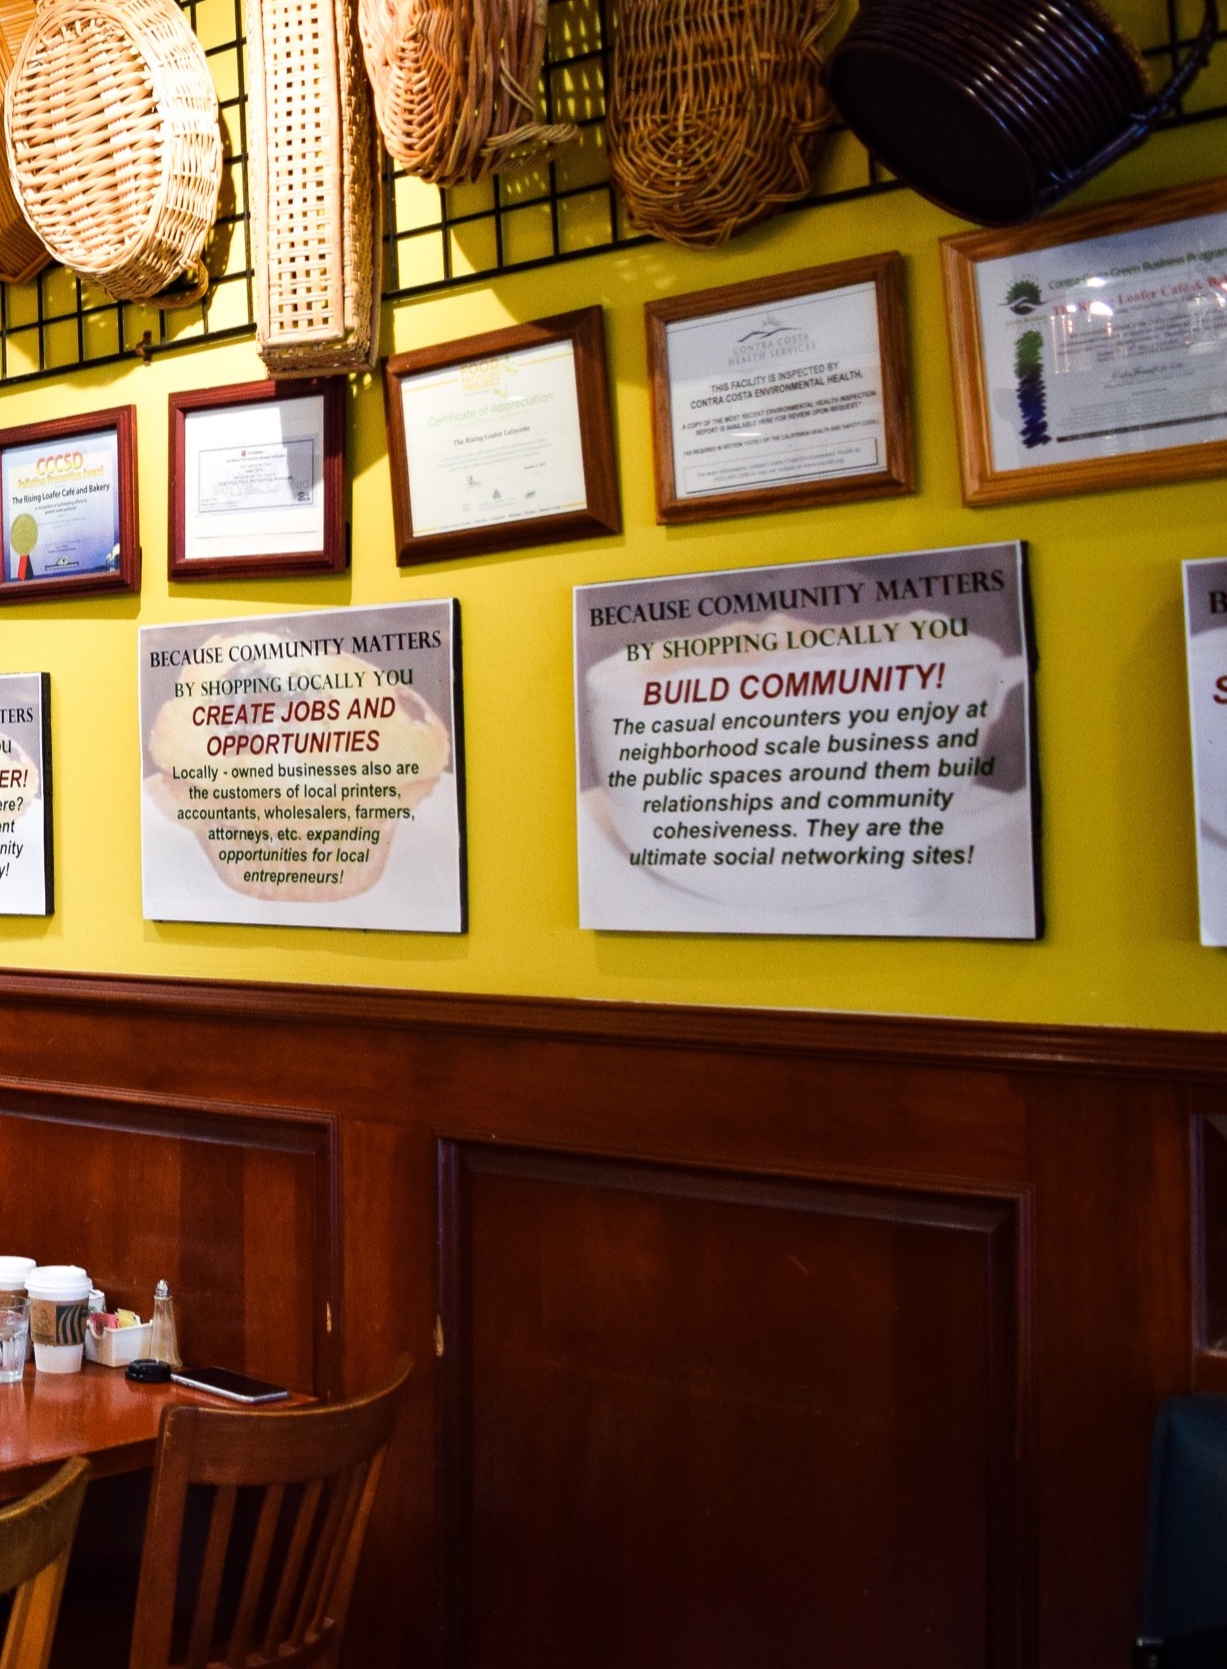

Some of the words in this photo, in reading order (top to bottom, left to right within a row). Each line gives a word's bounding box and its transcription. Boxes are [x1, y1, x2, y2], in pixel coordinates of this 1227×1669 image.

[728, 353, 765, 366] HEALTH
[770, 343, 816, 358] SERVICES
[733, 341, 772, 355] CONTRA
[777, 334, 809, 345] COSTA
[711, 384, 729, 394] THIS
[731, 377, 766, 390] FACILITY
[768, 373, 775, 383] IS
[778, 364, 824, 381] INSPECTED
[828, 362, 839, 372] BY
[690, 396, 724, 409] CONTRA
[726, 390, 753, 403] COSTA
[755, 377, 825, 398] ENVIRONMENTAL
[428, 409, 476, 427] Certificate
[479, 406, 488, 415] of
[492, 392, 554, 412] Appreciation
[466, 436, 484, 444] Rising
[485, 431, 503, 440] Loafer
[36, 451, 83, 475] CCCSD
[24, 494, 41, 503] Rising
[42, 491, 60, 500] Loafer
[76, 485, 87, 494] and
[89, 483, 110, 493] Bakery
[590, 600, 690, 627] BECAUSE
[698, 583, 866, 617] COMMUNITY
[876, 570, 1005, 602] MATTERS
[150, 647, 223, 668] BECAUSE
[229, 638, 344, 662] COMMUNITY
[352, 630, 441, 653] MATTERS
[626, 643, 656, 662] BY
[663, 632, 778, 659] SHOPPING
[786, 624, 900, 651] LOCALLY
[910, 618, 969, 640] YOU
[174, 682, 195, 698] BY
[200, 677, 282, 697] SHOPPING
[288, 672, 365, 692] LOCALLY
[373, 669, 413, 686] YOU
[644, 677, 729, 706] BUILD
[739, 662, 946, 700] COMMUNITY!
[192, 703, 275, 726] CREATE
[282, 700, 340, 722] JOBS
[347, 697, 395, 719] AND
[613, 717, 645, 736] The
[652, 714, 714, 734] casual
[722, 708, 841, 731] encounters
[849, 707, 889, 725] you
[898, 705, 959, 724] enjoy
[966, 700, 988, 718] at
[206, 730, 380, 756] OPPORTUNITIES
[619, 741, 757, 764] neighborhood
[765, 736, 820, 755] scale
[827, 732, 929, 753] business
[937, 729, 979, 748] and
[172, 766, 218, 781] Locally
[231, 765, 273, 778] owned
[278, 764, 356, 777] businesses
[362, 762, 391, 775] also
[396, 763, 419, 774] are
[608, 770, 636, 787] the
[642, 769, 703, 790] public
[709, 772, 782, 787] spaces
[789, 764, 866, 783] around
[874, 761, 930, 780] them
[937, 757, 995, 777] build
[189, 787, 208, 799] the
[213, 787, 281, 799] customers
[286, 786, 299, 798] of
[304, 785, 337, 798] local
[341, 785, 401, 801] printers,
[643, 794, 773, 816] relationships
[781, 793, 821, 811] and
[827, 790, 953, 812] community
[177, 807, 260, 821] accountants,
[264, 806, 351, 820] wholesalers,
[355, 805, 414, 820] farmers,
[208, 828, 273, 842] attorneys,
[277, 828, 301, 841] etc.
[306, 827, 380, 844] expanding
[653, 820, 797, 840] cohesiveness.
[806, 818, 859, 841] They
[866, 822, 902, 836] are
[909, 818, 944, 836] the
[218, 849, 307, 863] opportunities
[312, 849, 333, 862] for
[336, 849, 369, 862] local
[629, 849, 706, 867] ultimate
[714, 847, 773, 865] social
[781, 847, 904, 869] networking
[912, 845, 974, 865] sites!
[244, 870, 344, 886] entrepreneurs!
